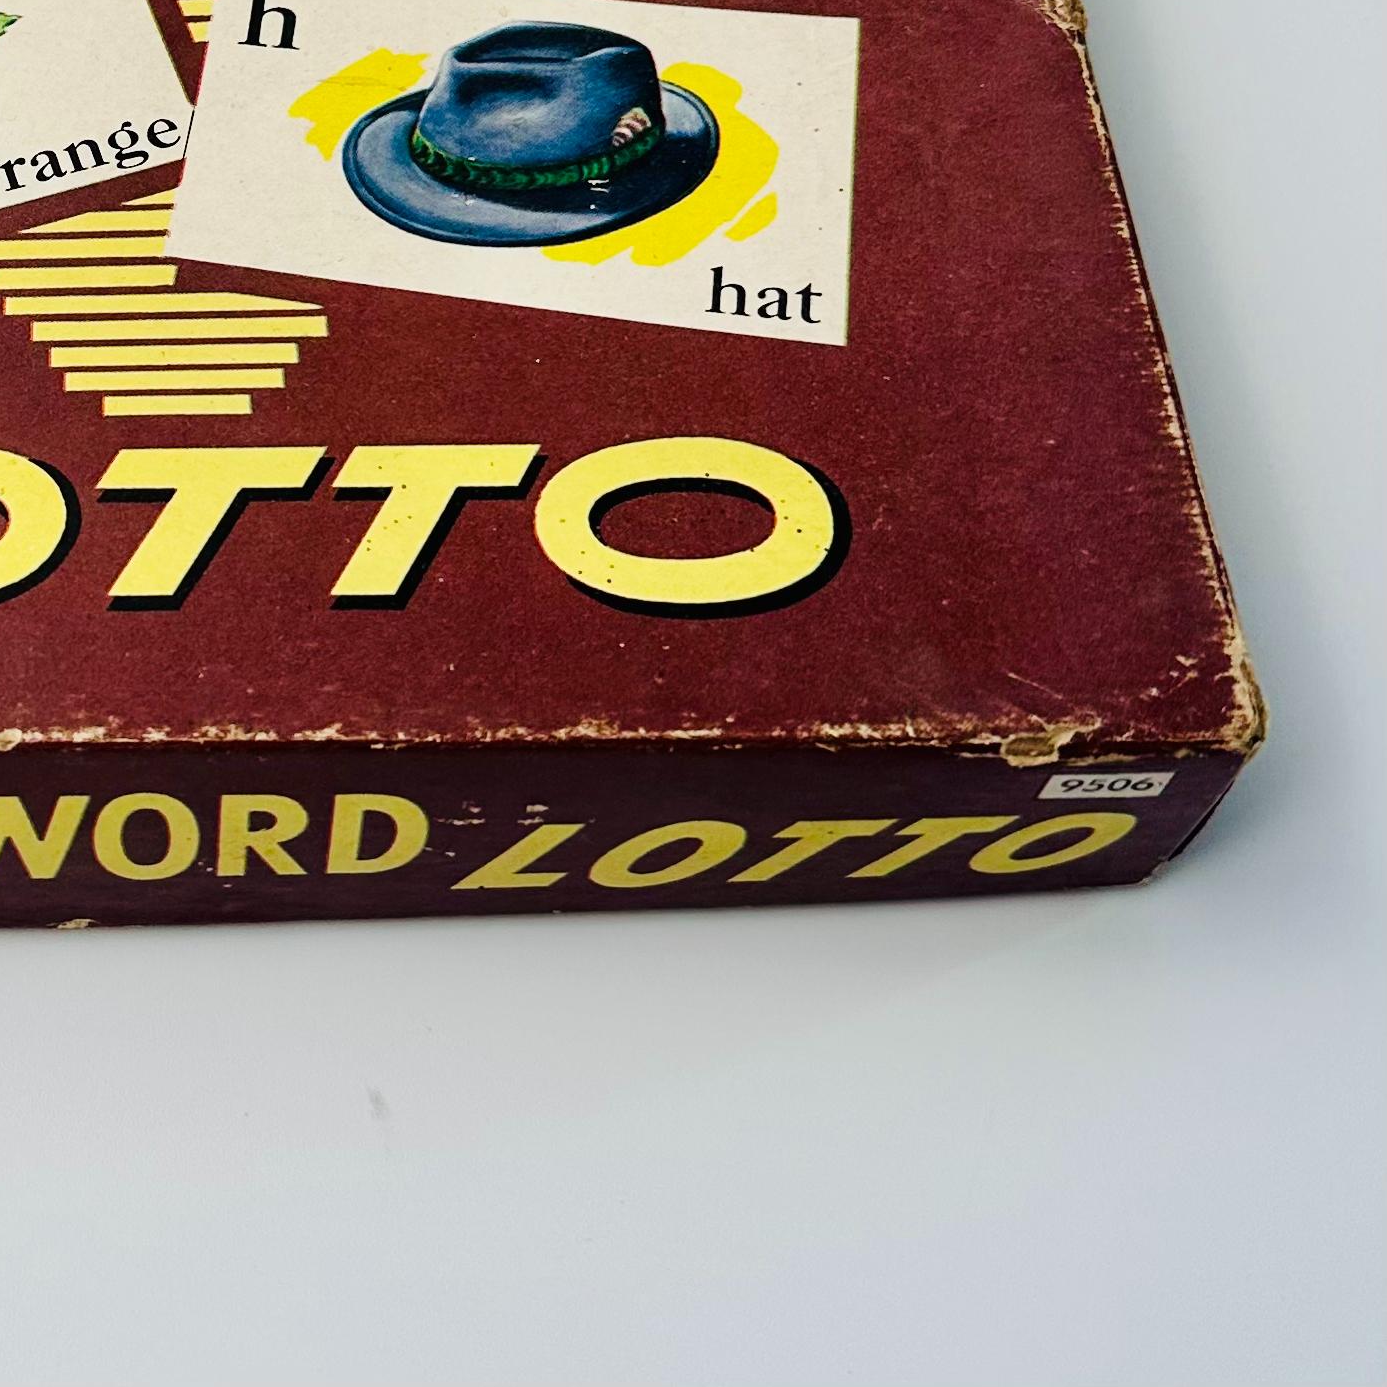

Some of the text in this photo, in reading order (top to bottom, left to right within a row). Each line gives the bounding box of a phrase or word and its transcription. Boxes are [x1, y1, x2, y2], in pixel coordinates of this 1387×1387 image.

[705, 265, 823, 325] hat
[1059, 774, 1155, 795] 9506
[450, 811, 1137, 890] LOTTO
